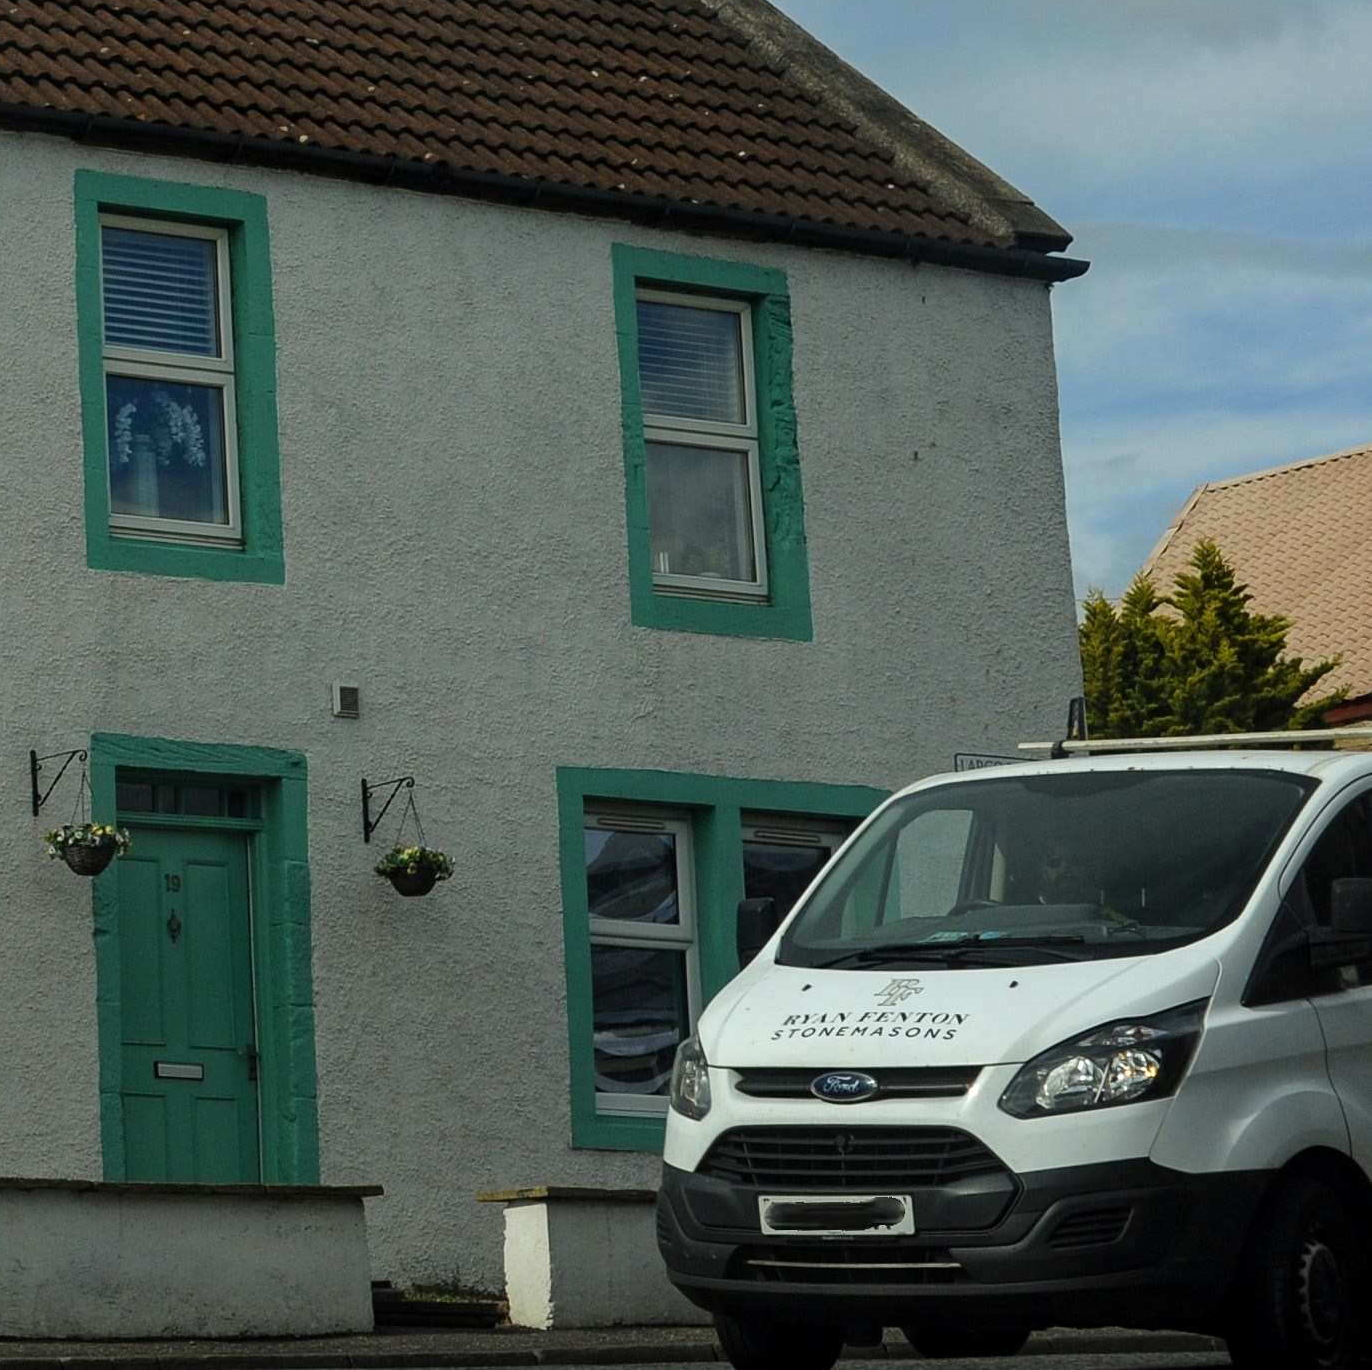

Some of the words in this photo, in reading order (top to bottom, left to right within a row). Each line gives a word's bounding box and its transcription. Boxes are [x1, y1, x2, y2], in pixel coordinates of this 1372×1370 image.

[163, 873, 182, 893] 19
[782, 1012, 853, 1027] RYAN
[857, 1011, 971, 1026] FENTON
[770, 1026, 958, 1041] STONEMASONS
[823, 1075, 860, 1092] Ford
